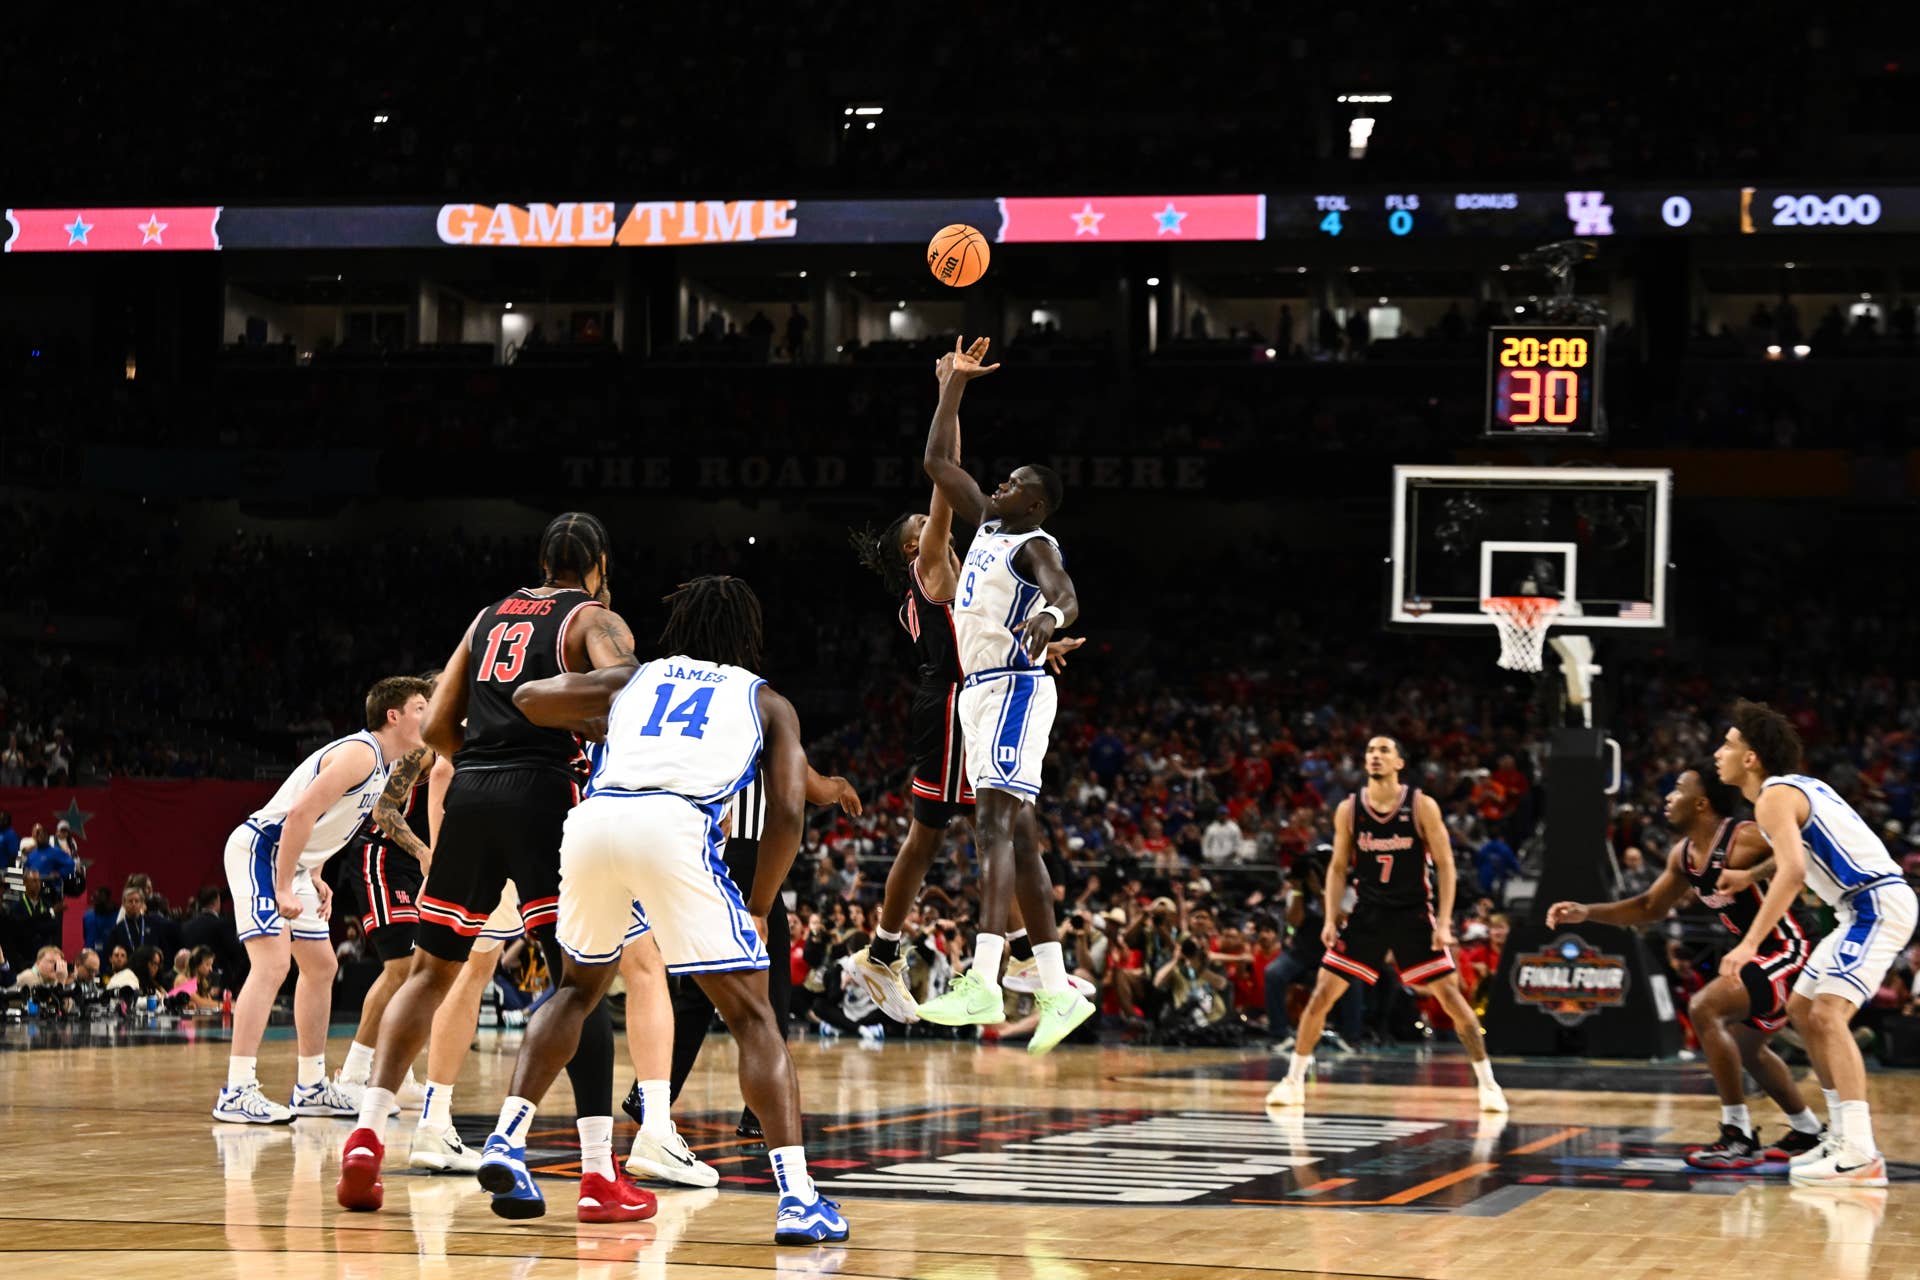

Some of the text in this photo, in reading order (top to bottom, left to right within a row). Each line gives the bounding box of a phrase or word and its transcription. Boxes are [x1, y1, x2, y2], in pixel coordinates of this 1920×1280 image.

[1314, 196, 1349, 211] TOL
[1385, 195, 1419, 210] FLS
[1661, 196, 1692, 227] 0
[1772, 194, 1881, 226] 20:00
[436, 200, 798, 245] GAME TIME
[1320, 210, 1343, 236] 4
[1389, 209, 1414, 236] 0
[1501, 338, 1587, 367] 20:00
[1510, 370, 1578, 423] 30
[560, 455, 673, 488] THE
[696, 455, 848, 488] ROAD
[962, 572, 976, 608] 9
[476, 621, 535, 682] 13
[664, 664, 728, 683] JAMES
[640, 683, 716, 740] 14
[998, 746, 1016, 762] D
[1376, 854, 1394, 883] 7
